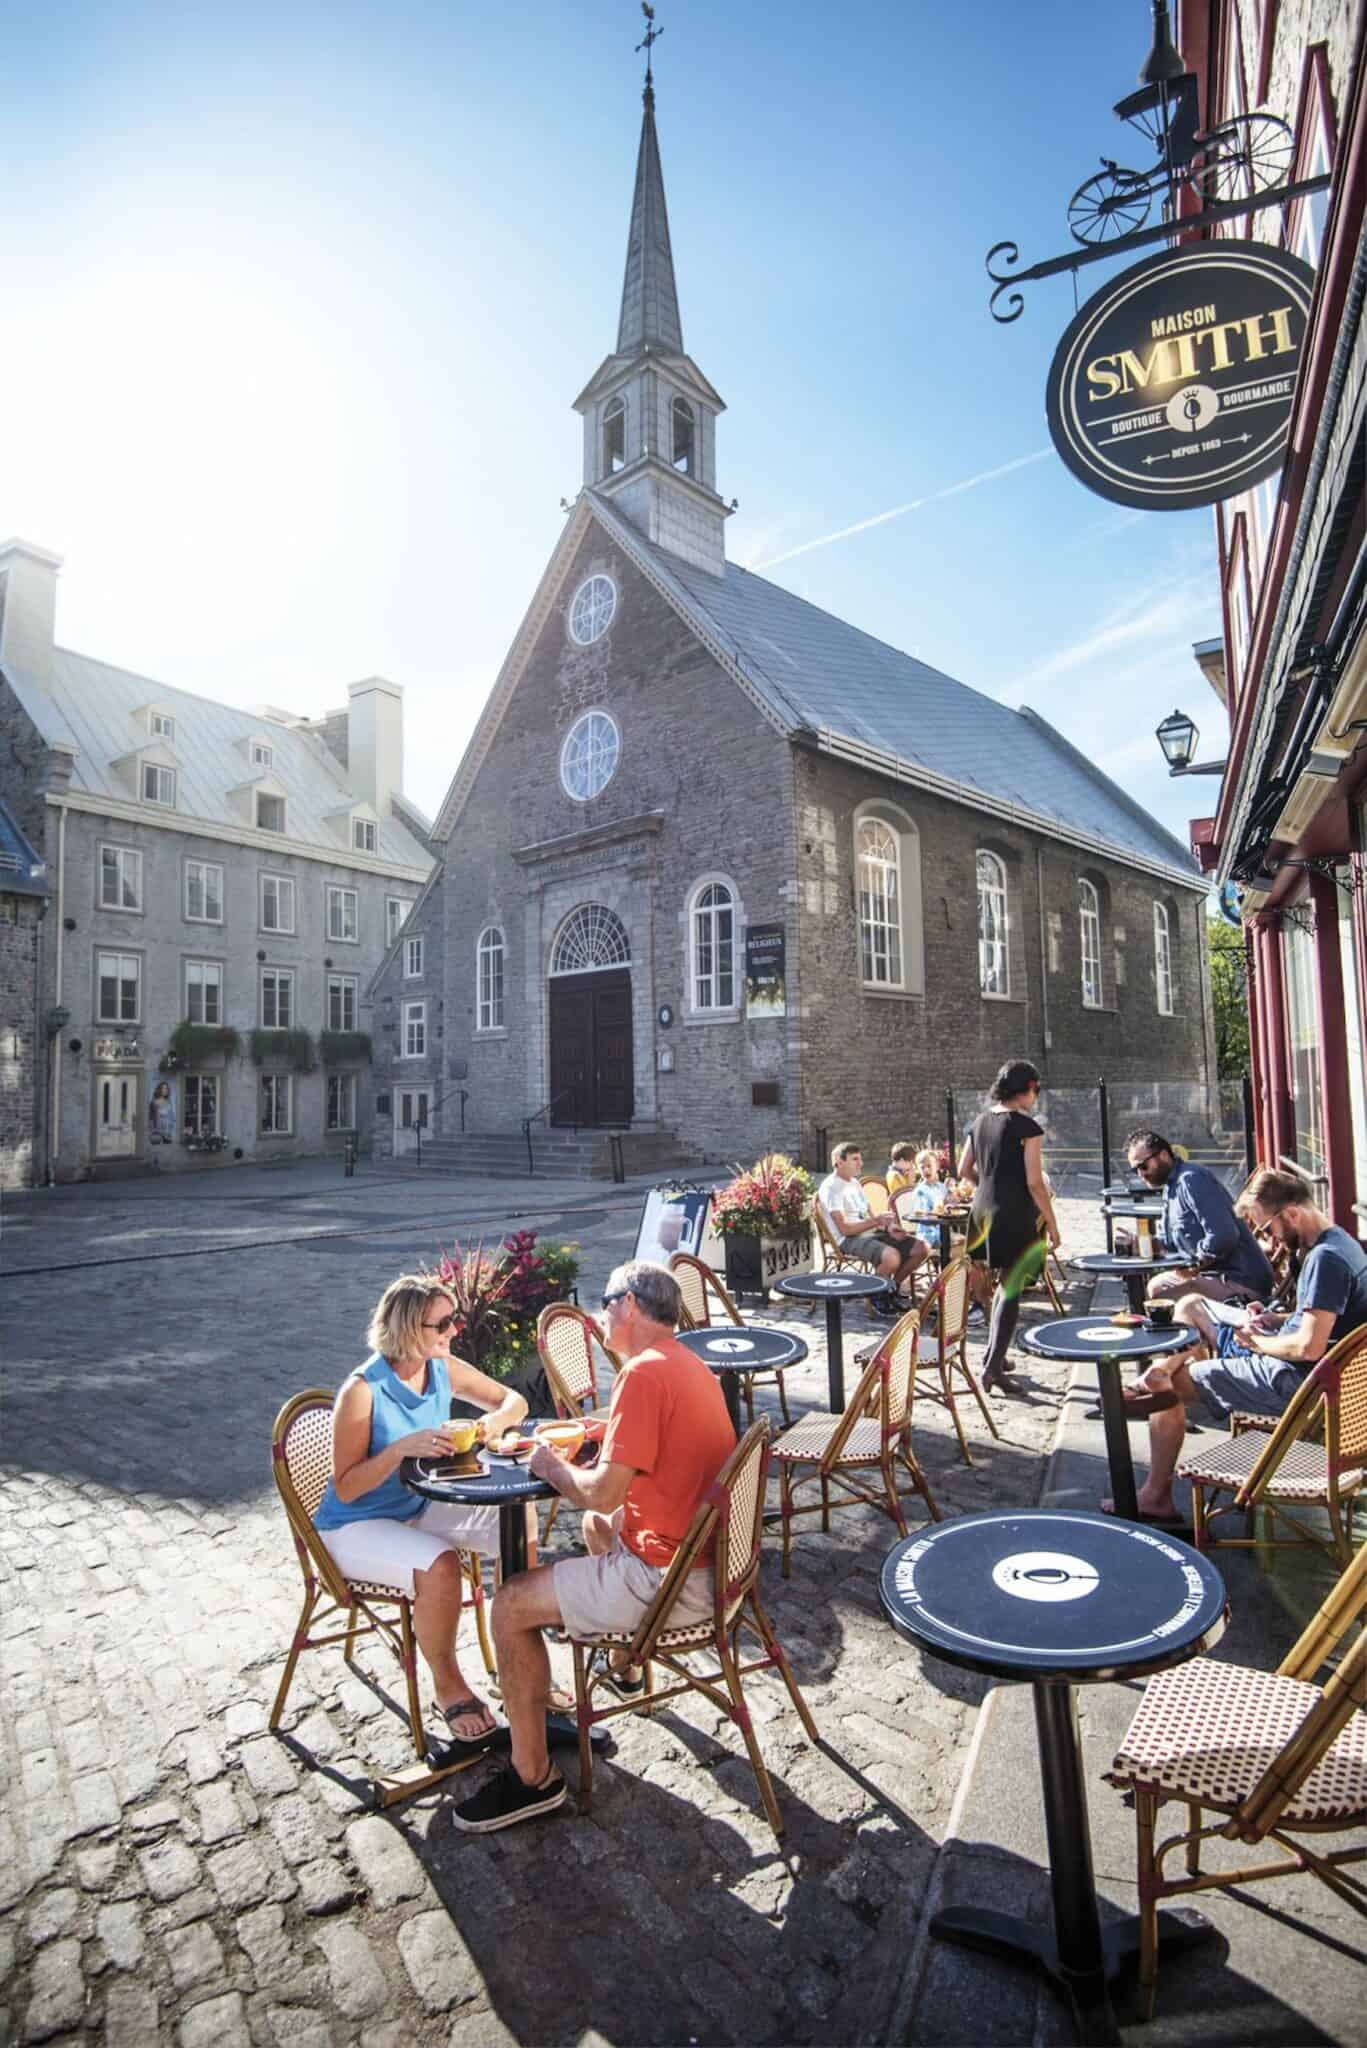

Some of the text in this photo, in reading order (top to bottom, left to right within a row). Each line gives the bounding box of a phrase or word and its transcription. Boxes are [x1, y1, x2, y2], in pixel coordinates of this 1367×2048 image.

[1151, 304, 1217, 337] MAISON
[1086, 307, 1297, 402] SMITH
[1112, 379, 1291, 435] BOUTIQUE GOURMANDE
